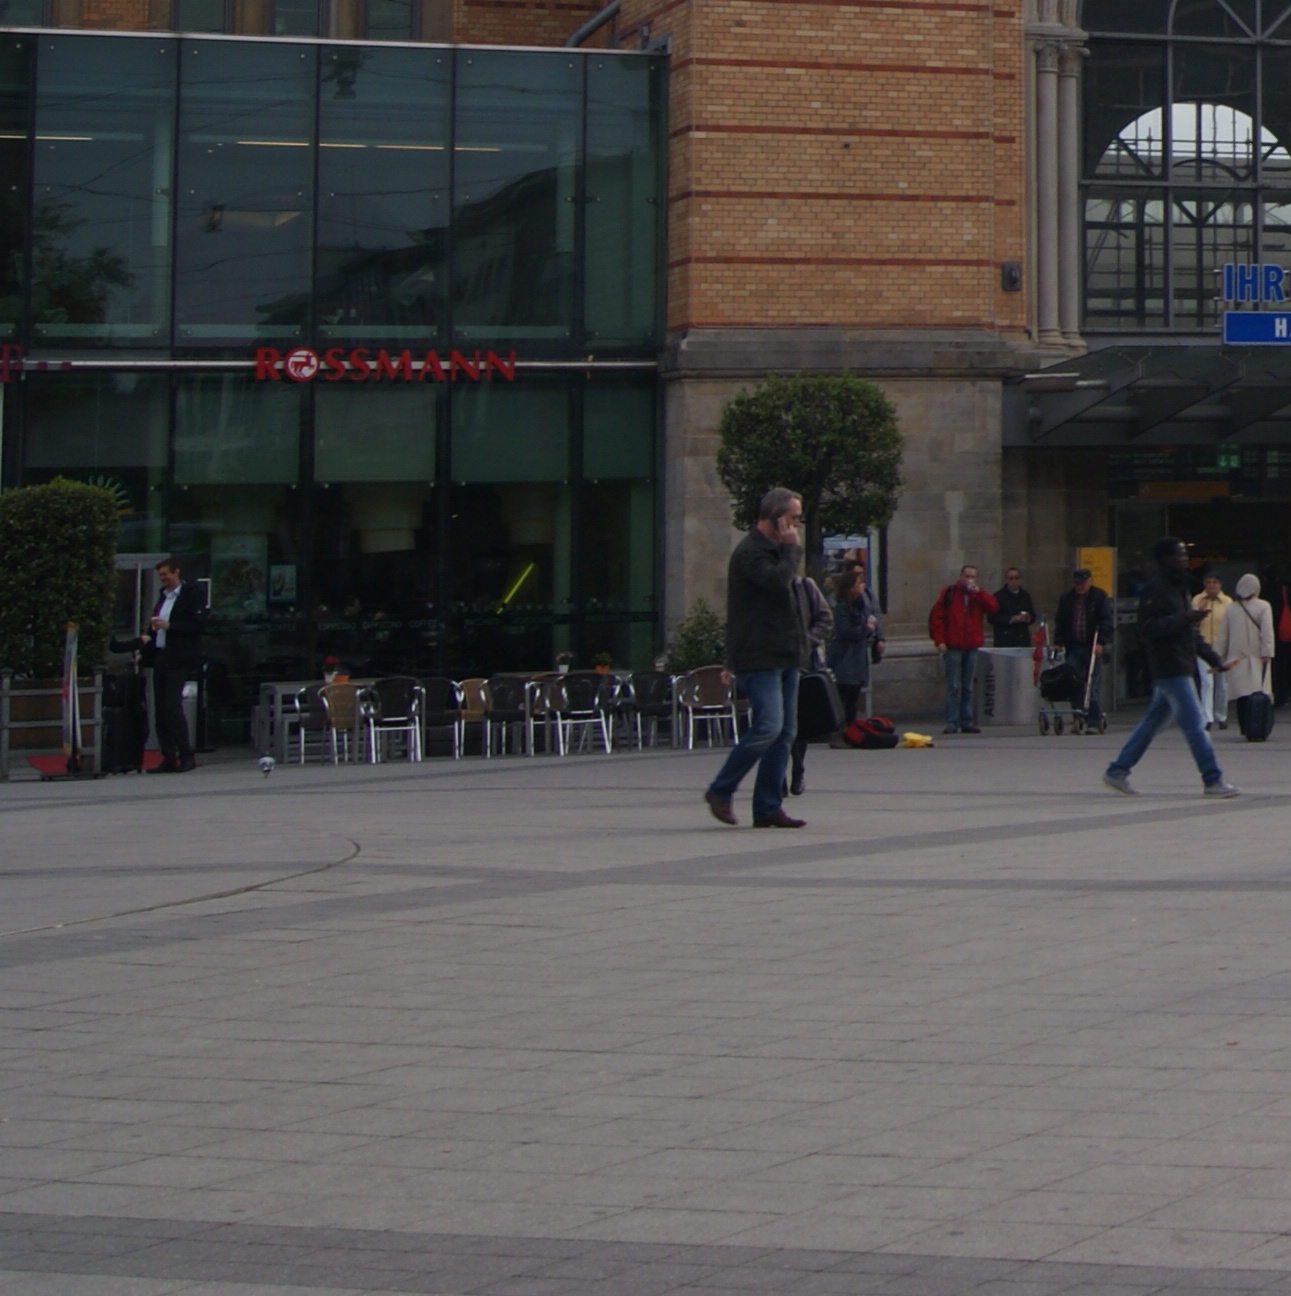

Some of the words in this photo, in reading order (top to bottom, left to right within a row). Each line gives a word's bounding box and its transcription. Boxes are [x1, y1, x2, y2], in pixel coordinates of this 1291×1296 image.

[1223, 263, 1285, 303] IHR
[255, 346, 517, 384] ROSSMANN
[984, 674, 996, 717] Abfall
